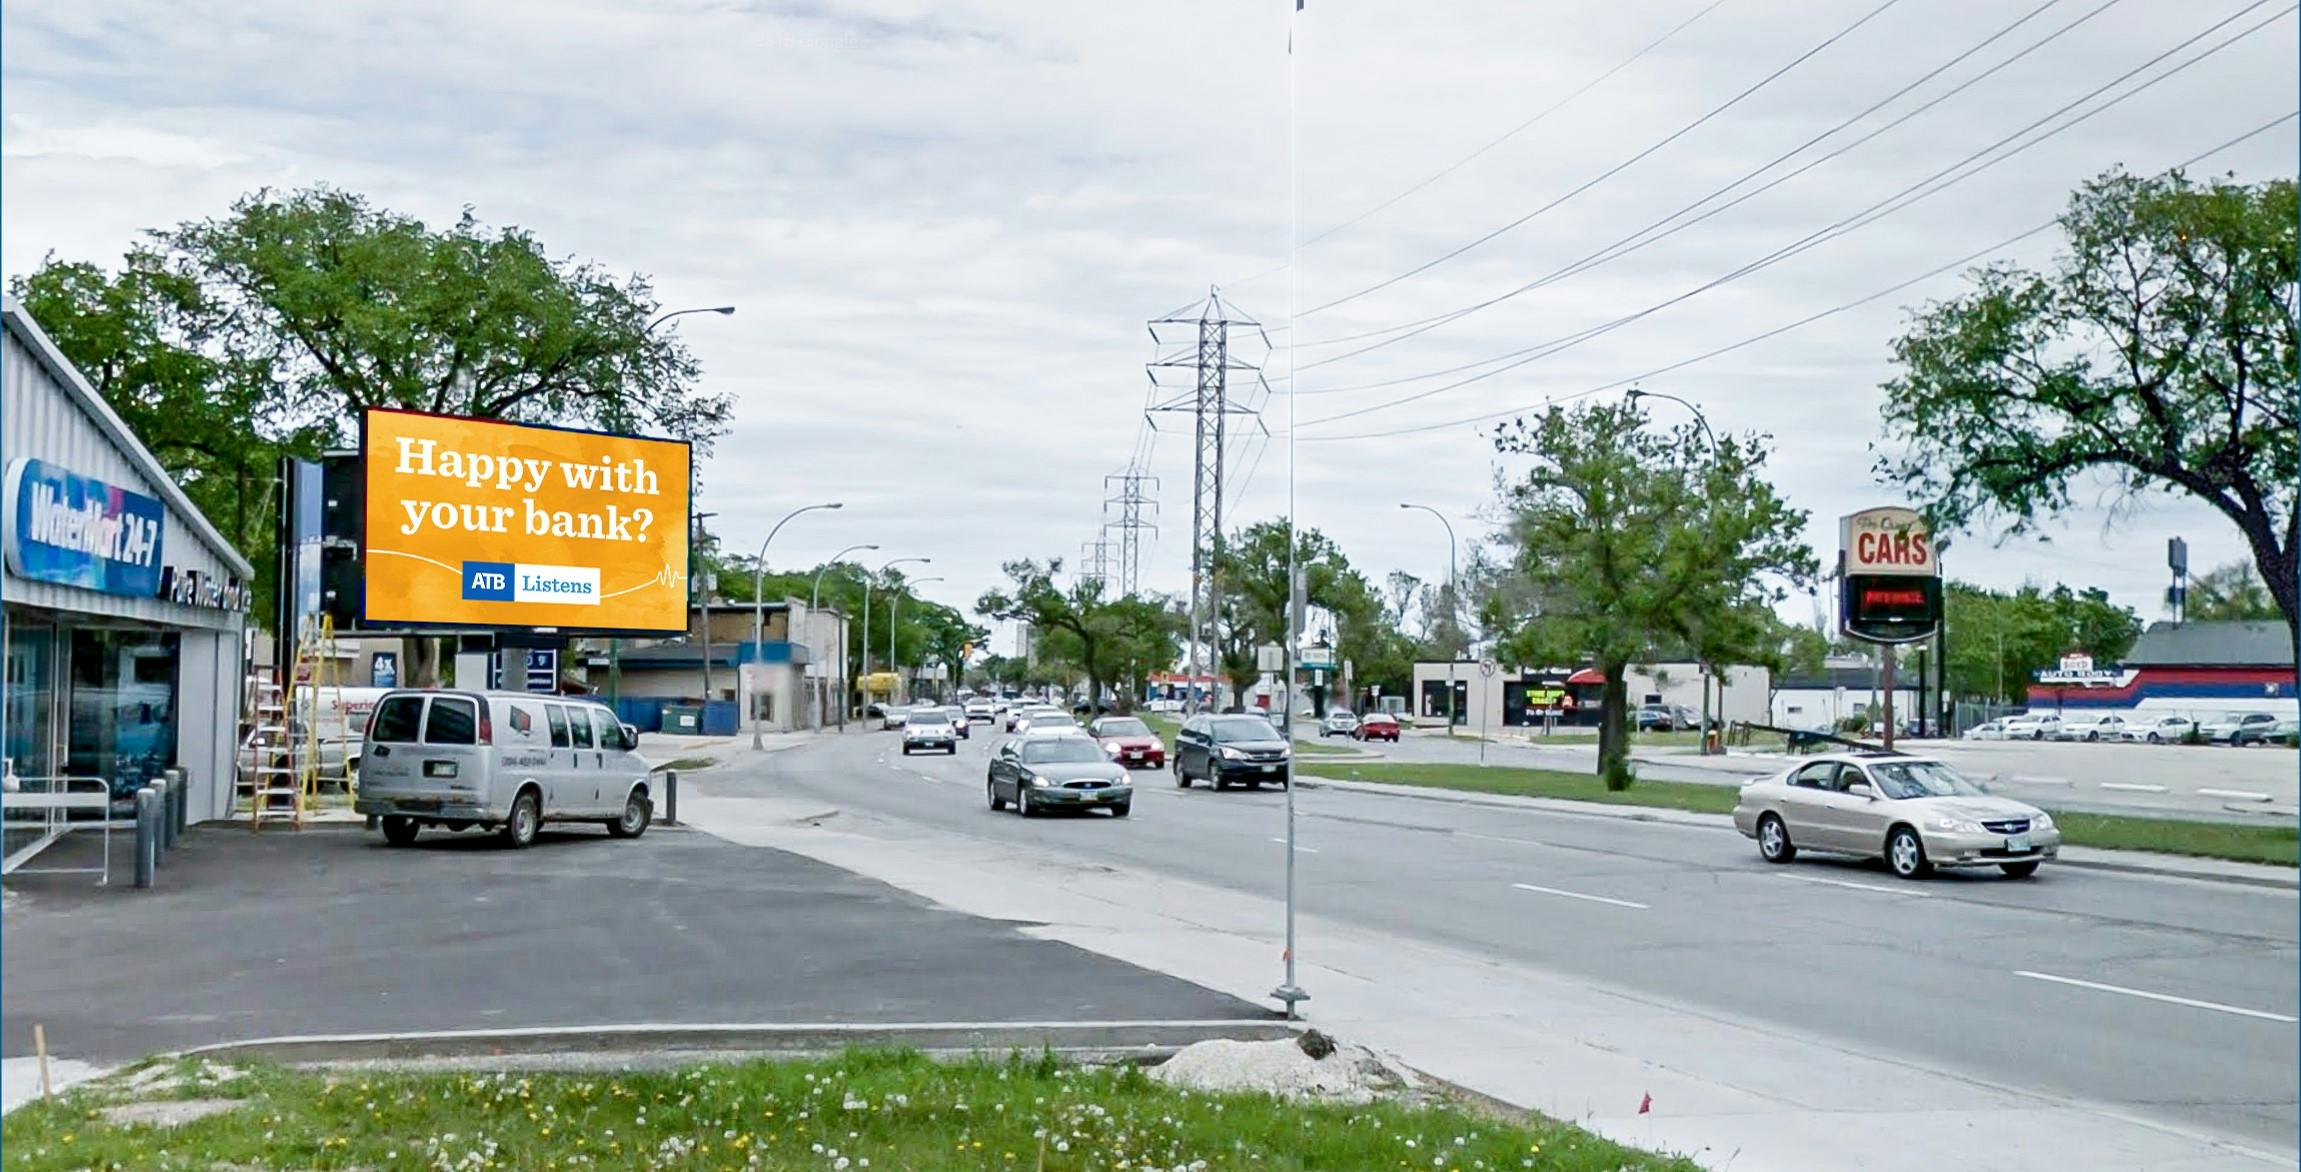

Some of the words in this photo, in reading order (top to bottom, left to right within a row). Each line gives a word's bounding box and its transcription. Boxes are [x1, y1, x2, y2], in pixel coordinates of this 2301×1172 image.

[395, 437, 552, 493] Happy
[560, 455, 660, 495] with
[31, 481, 123, 561] WaterMart
[123, 512, 158, 568] 24-7
[401, 499, 514, 536] your
[523, 498, 654, 543] bank?
[1858, 532, 1927, 565] CARS
[471, 571, 506, 591] ATB
[522, 575, 592, 594] Listens
